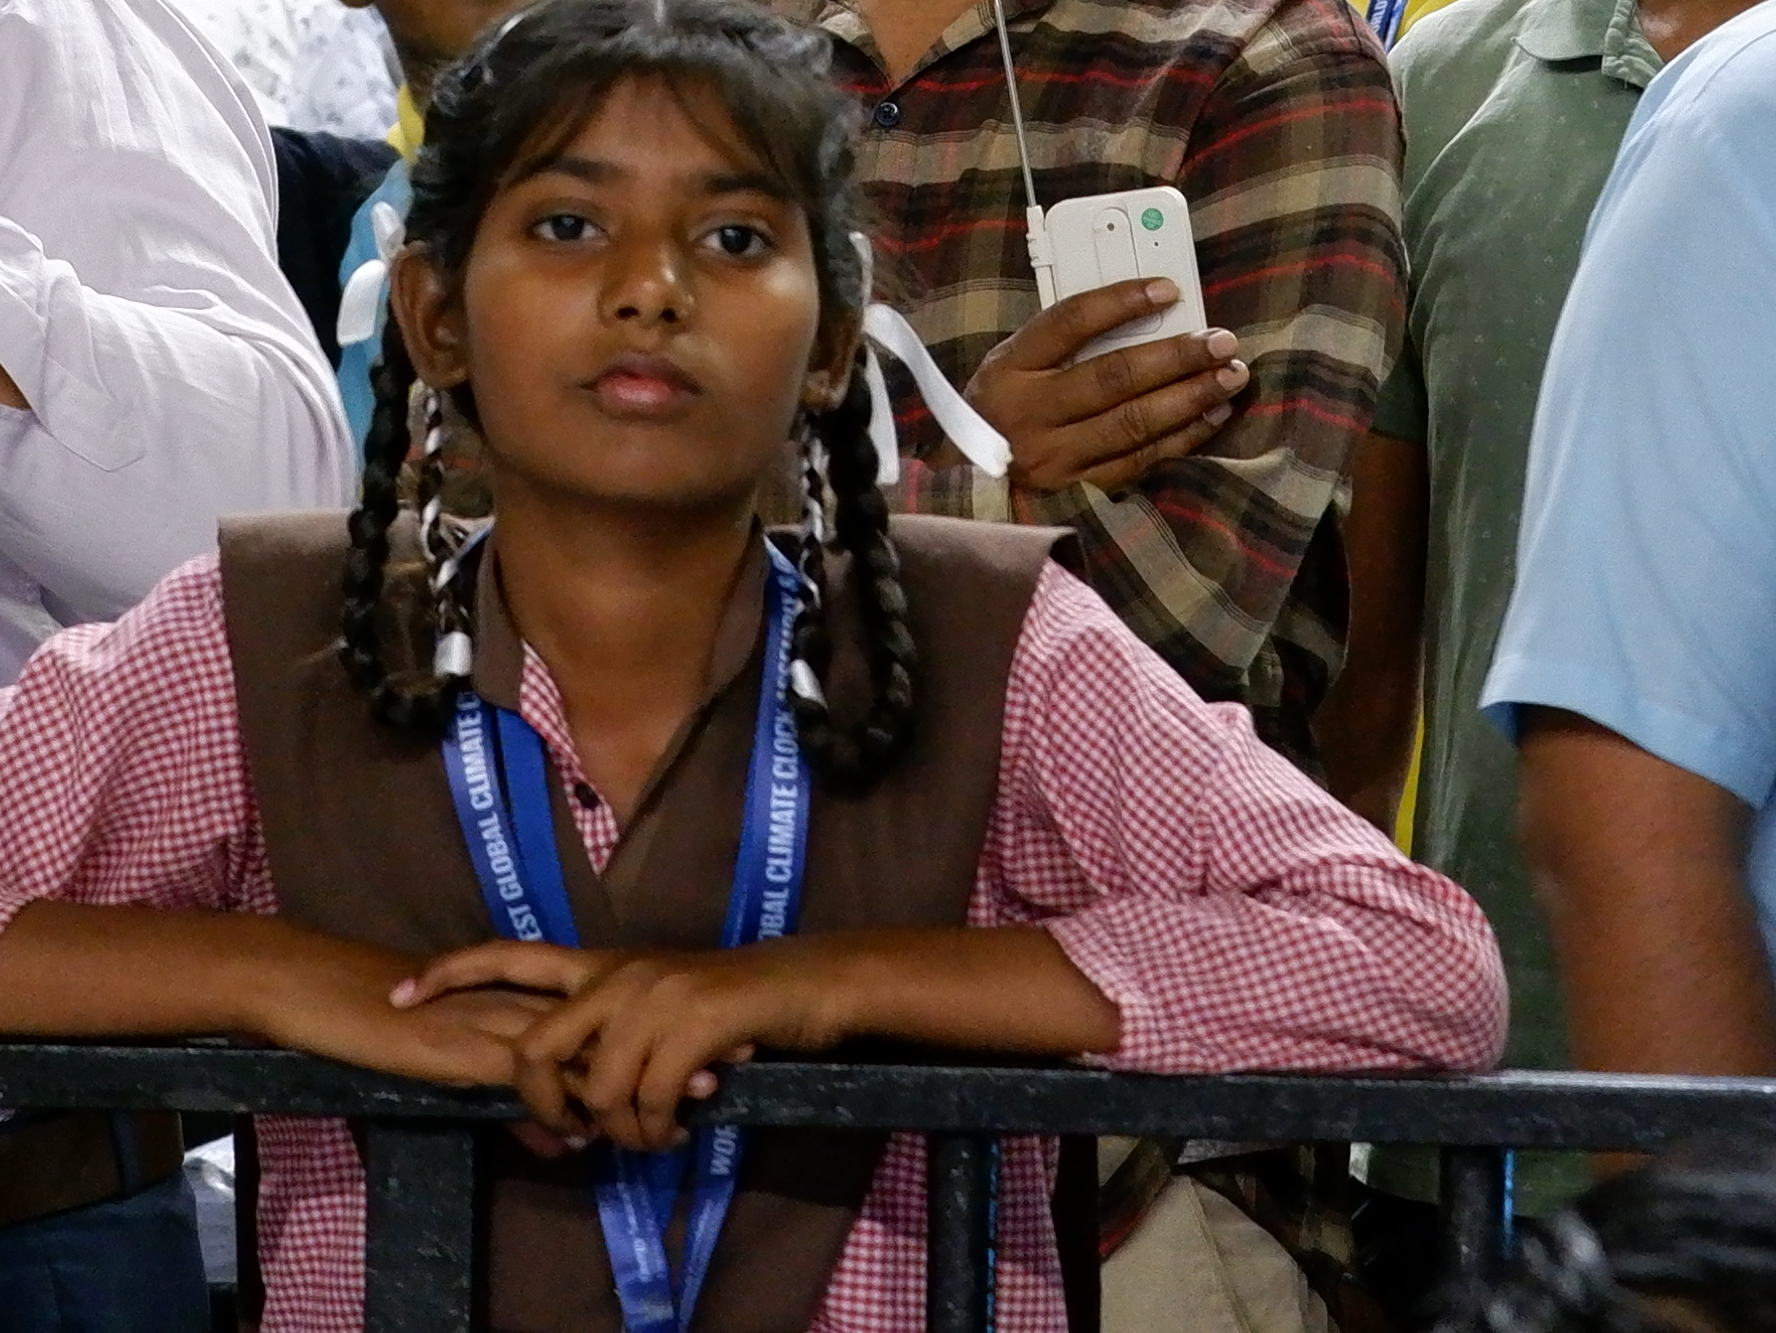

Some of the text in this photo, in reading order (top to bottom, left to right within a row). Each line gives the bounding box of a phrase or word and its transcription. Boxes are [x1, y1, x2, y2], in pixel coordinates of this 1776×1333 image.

[457, 712, 493, 809] CLIMATE
[477, 811, 524, 900] GLOBAL
[765, 781, 798, 885] CLIMATE
